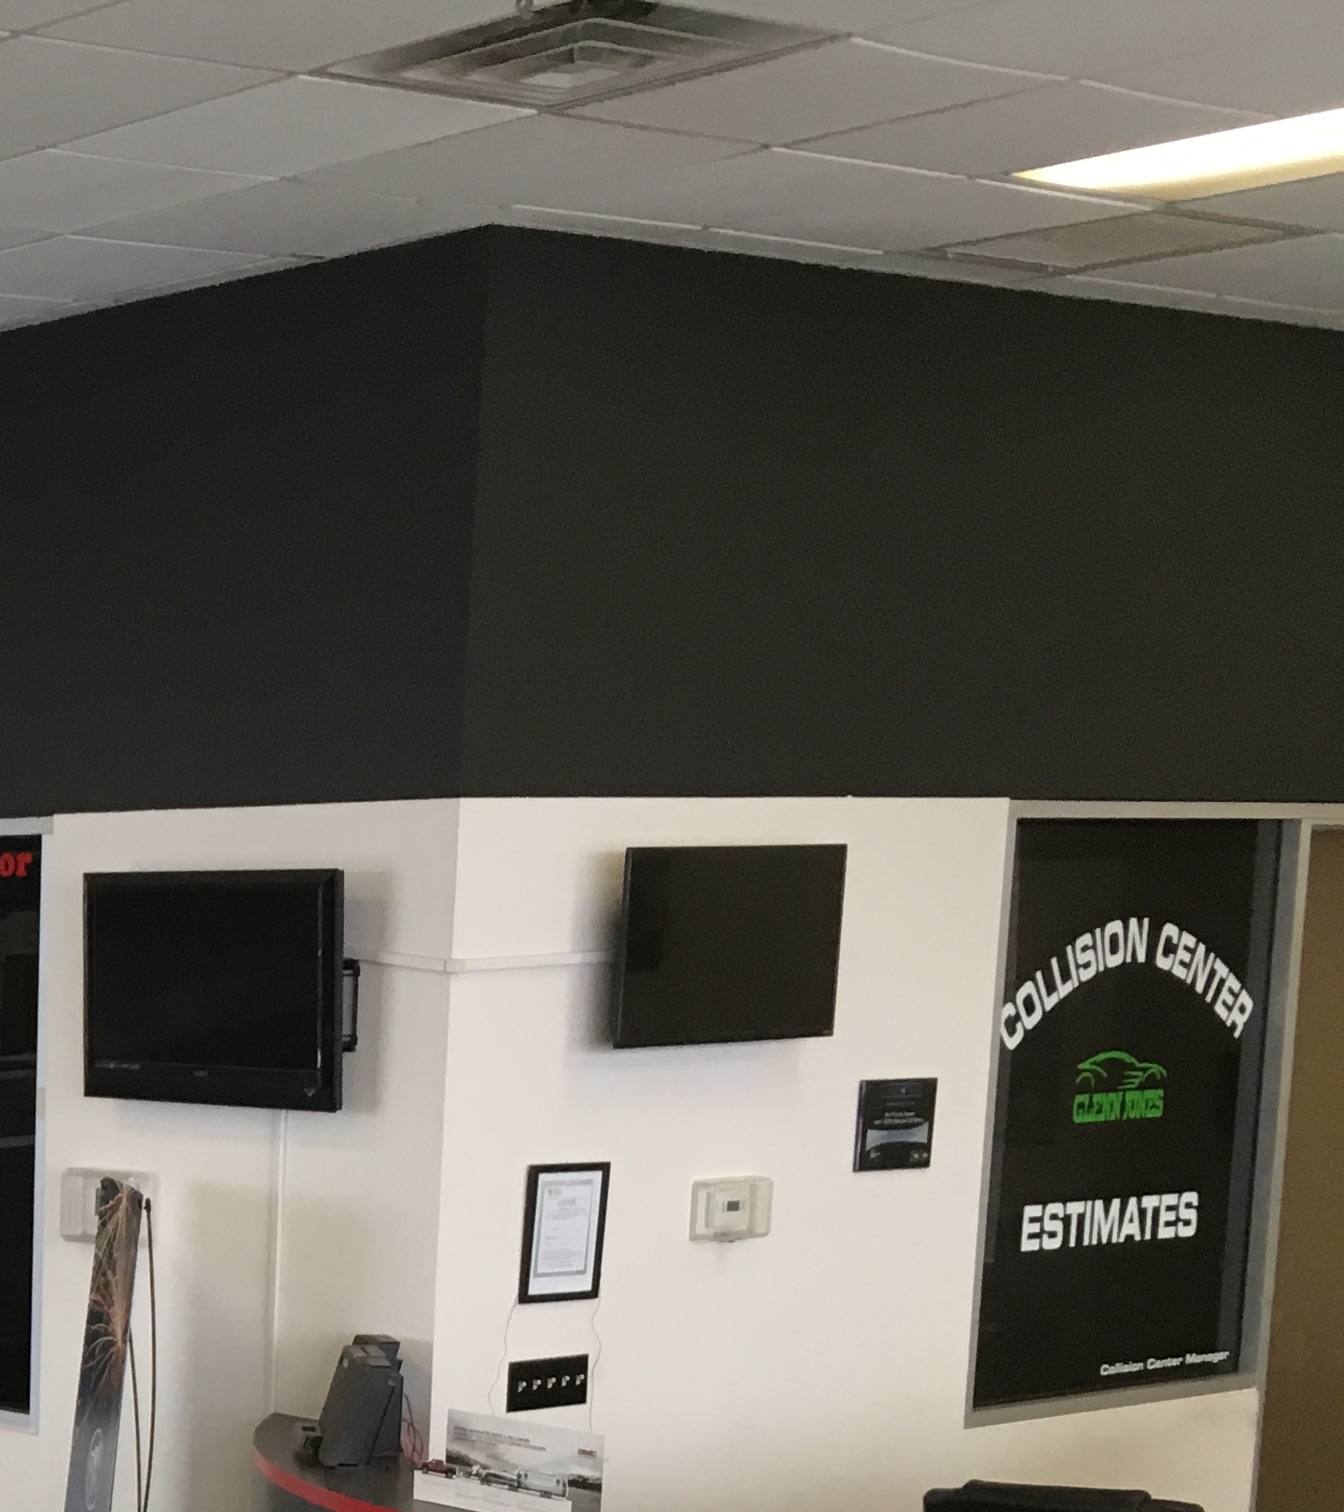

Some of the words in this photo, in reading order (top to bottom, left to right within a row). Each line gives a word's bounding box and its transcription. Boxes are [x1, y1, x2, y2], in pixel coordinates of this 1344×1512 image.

[1000, 917, 1150, 1051] COLLISION
[1155, 922, 1254, 1039] CENTER
[1020, 1191, 1199, 1252] ESTIMATES
[1100, 1361, 1144, 1376] Collision
[1146, 1357, 1184, 1370] Center
[1185, 1351, 1230, 1365] Manager
